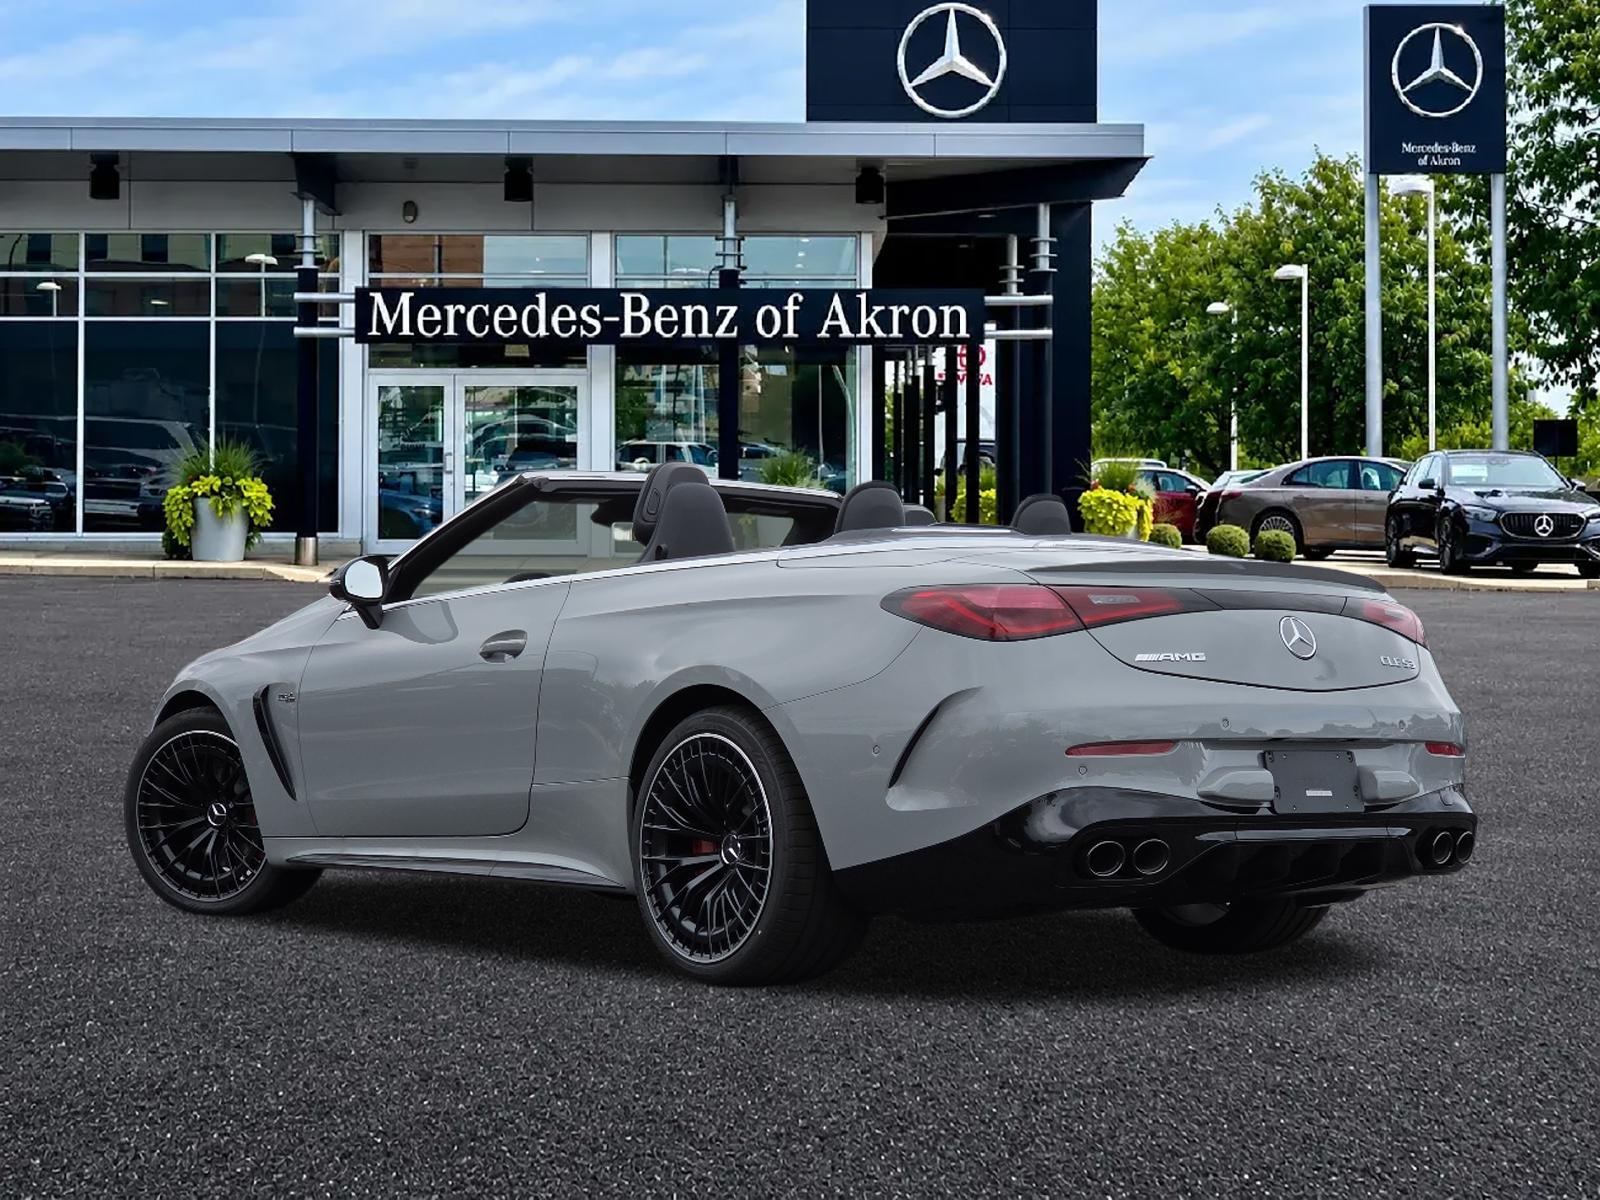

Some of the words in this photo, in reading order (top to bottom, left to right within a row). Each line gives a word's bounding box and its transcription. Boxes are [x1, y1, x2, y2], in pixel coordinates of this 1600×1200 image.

[1401, 142, 1476, 153] Mercedes-Benz
[1418, 155, 1428, 166] of
[1430, 155, 1461, 166] Akron
[367, 291, 738, 338] Mercedes-Benz
[755, 292, 804, 339] of
[816, 292, 970, 339] Akron
[1159, 652, 1207, 662] AMG
